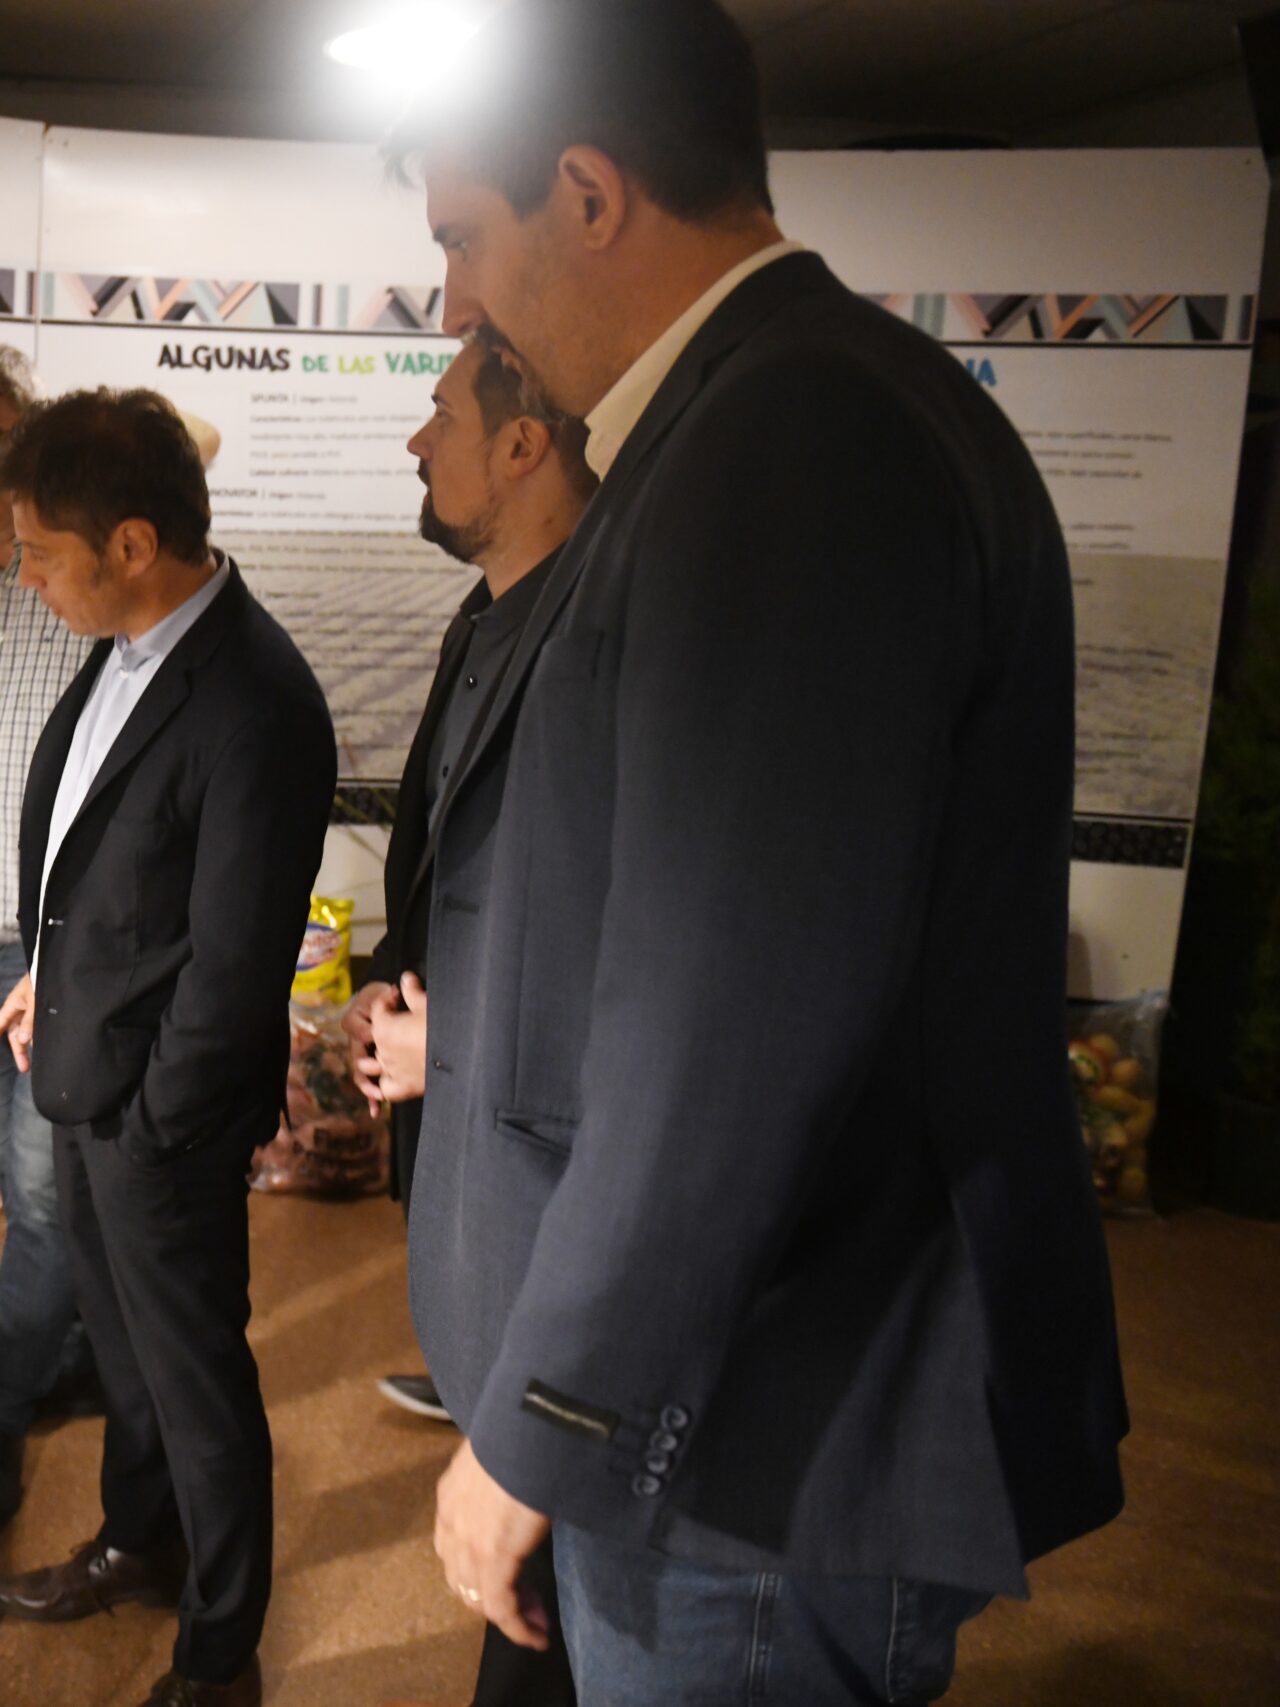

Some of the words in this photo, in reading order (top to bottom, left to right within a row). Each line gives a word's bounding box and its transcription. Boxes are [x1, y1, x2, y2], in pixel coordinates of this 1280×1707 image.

[157, 345, 290, 372] ALGUNAS
[302, 355, 329, 373] DE
[338, 354, 376, 375] LAS
[385, 352, 458, 375] VARI
